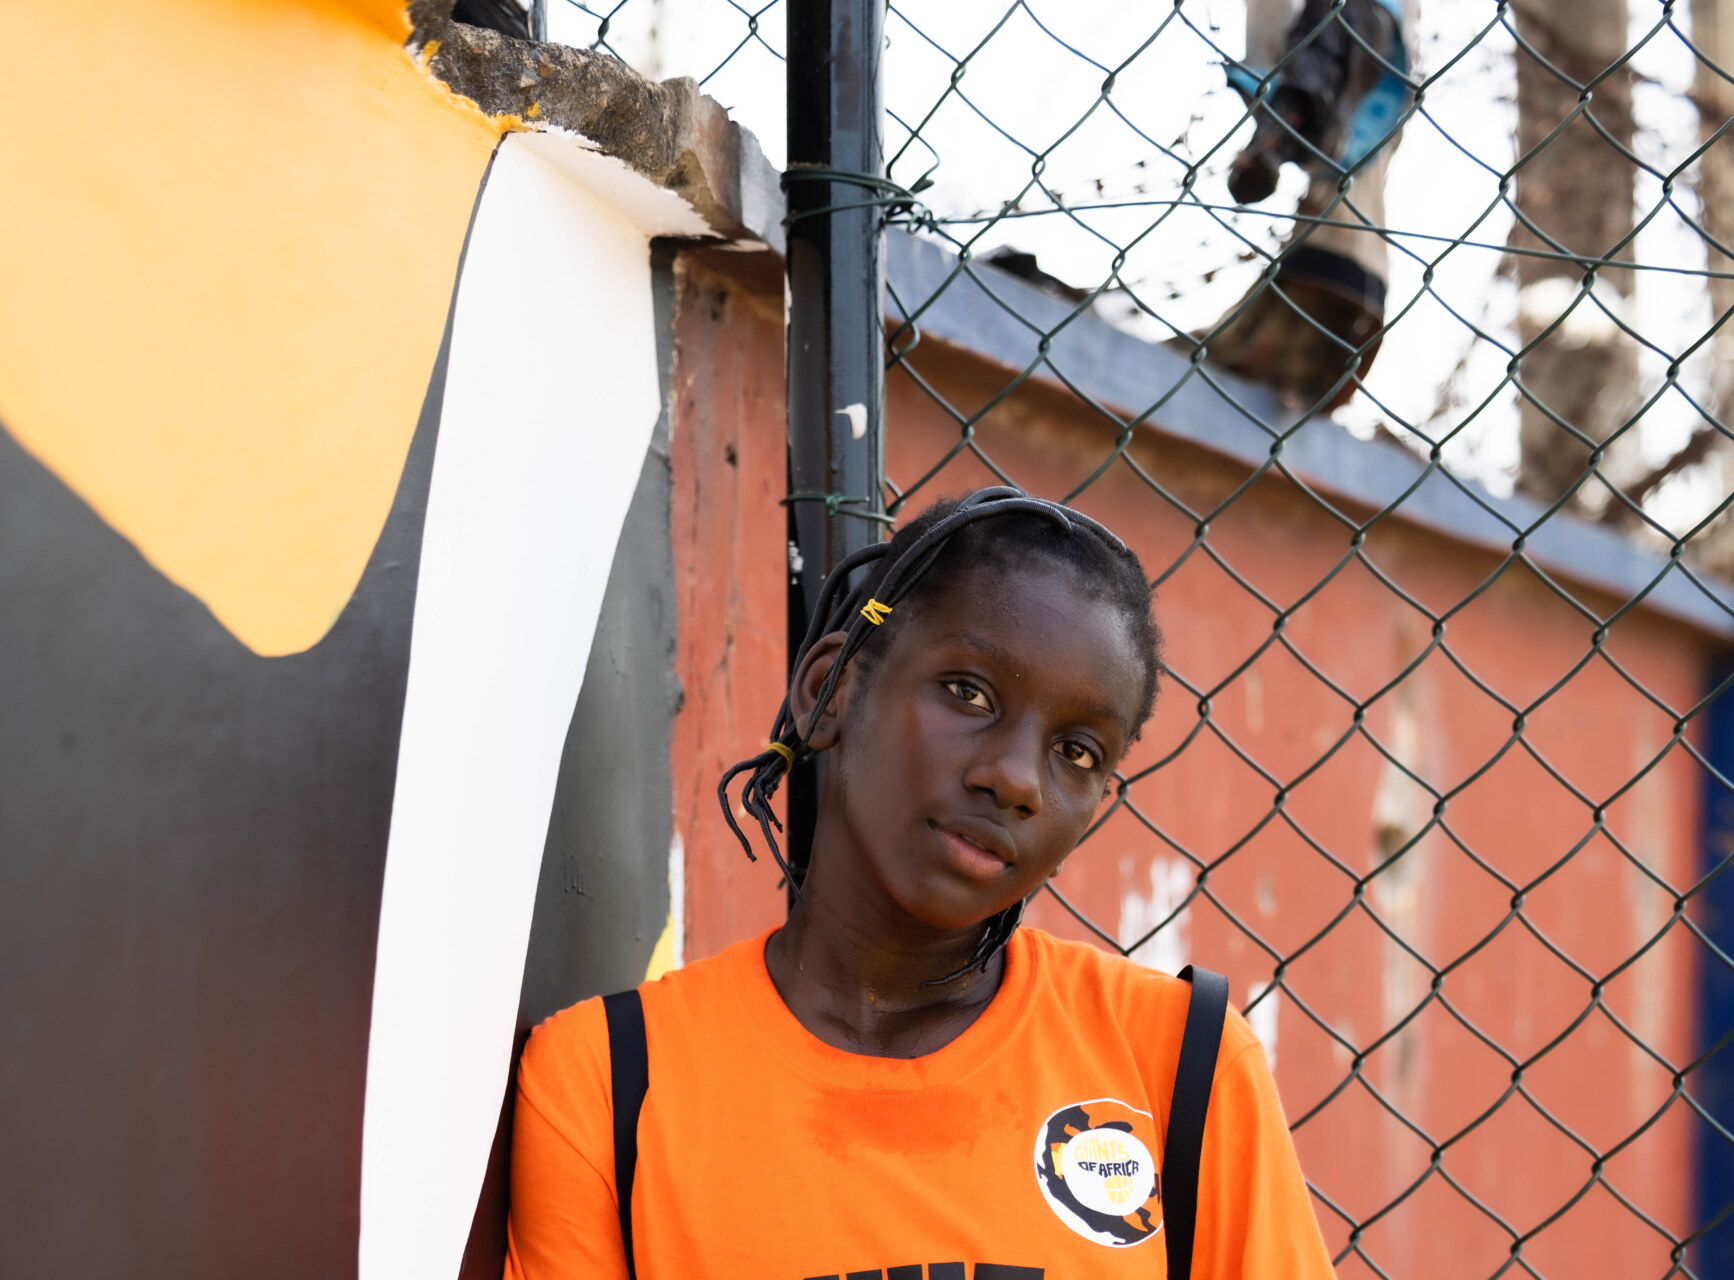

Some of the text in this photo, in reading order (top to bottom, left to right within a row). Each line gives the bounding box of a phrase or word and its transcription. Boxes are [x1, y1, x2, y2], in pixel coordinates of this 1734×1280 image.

[1073, 1137, 1131, 1162] GIANTS
[1077, 1159, 1140, 1179] OF AFRICA
